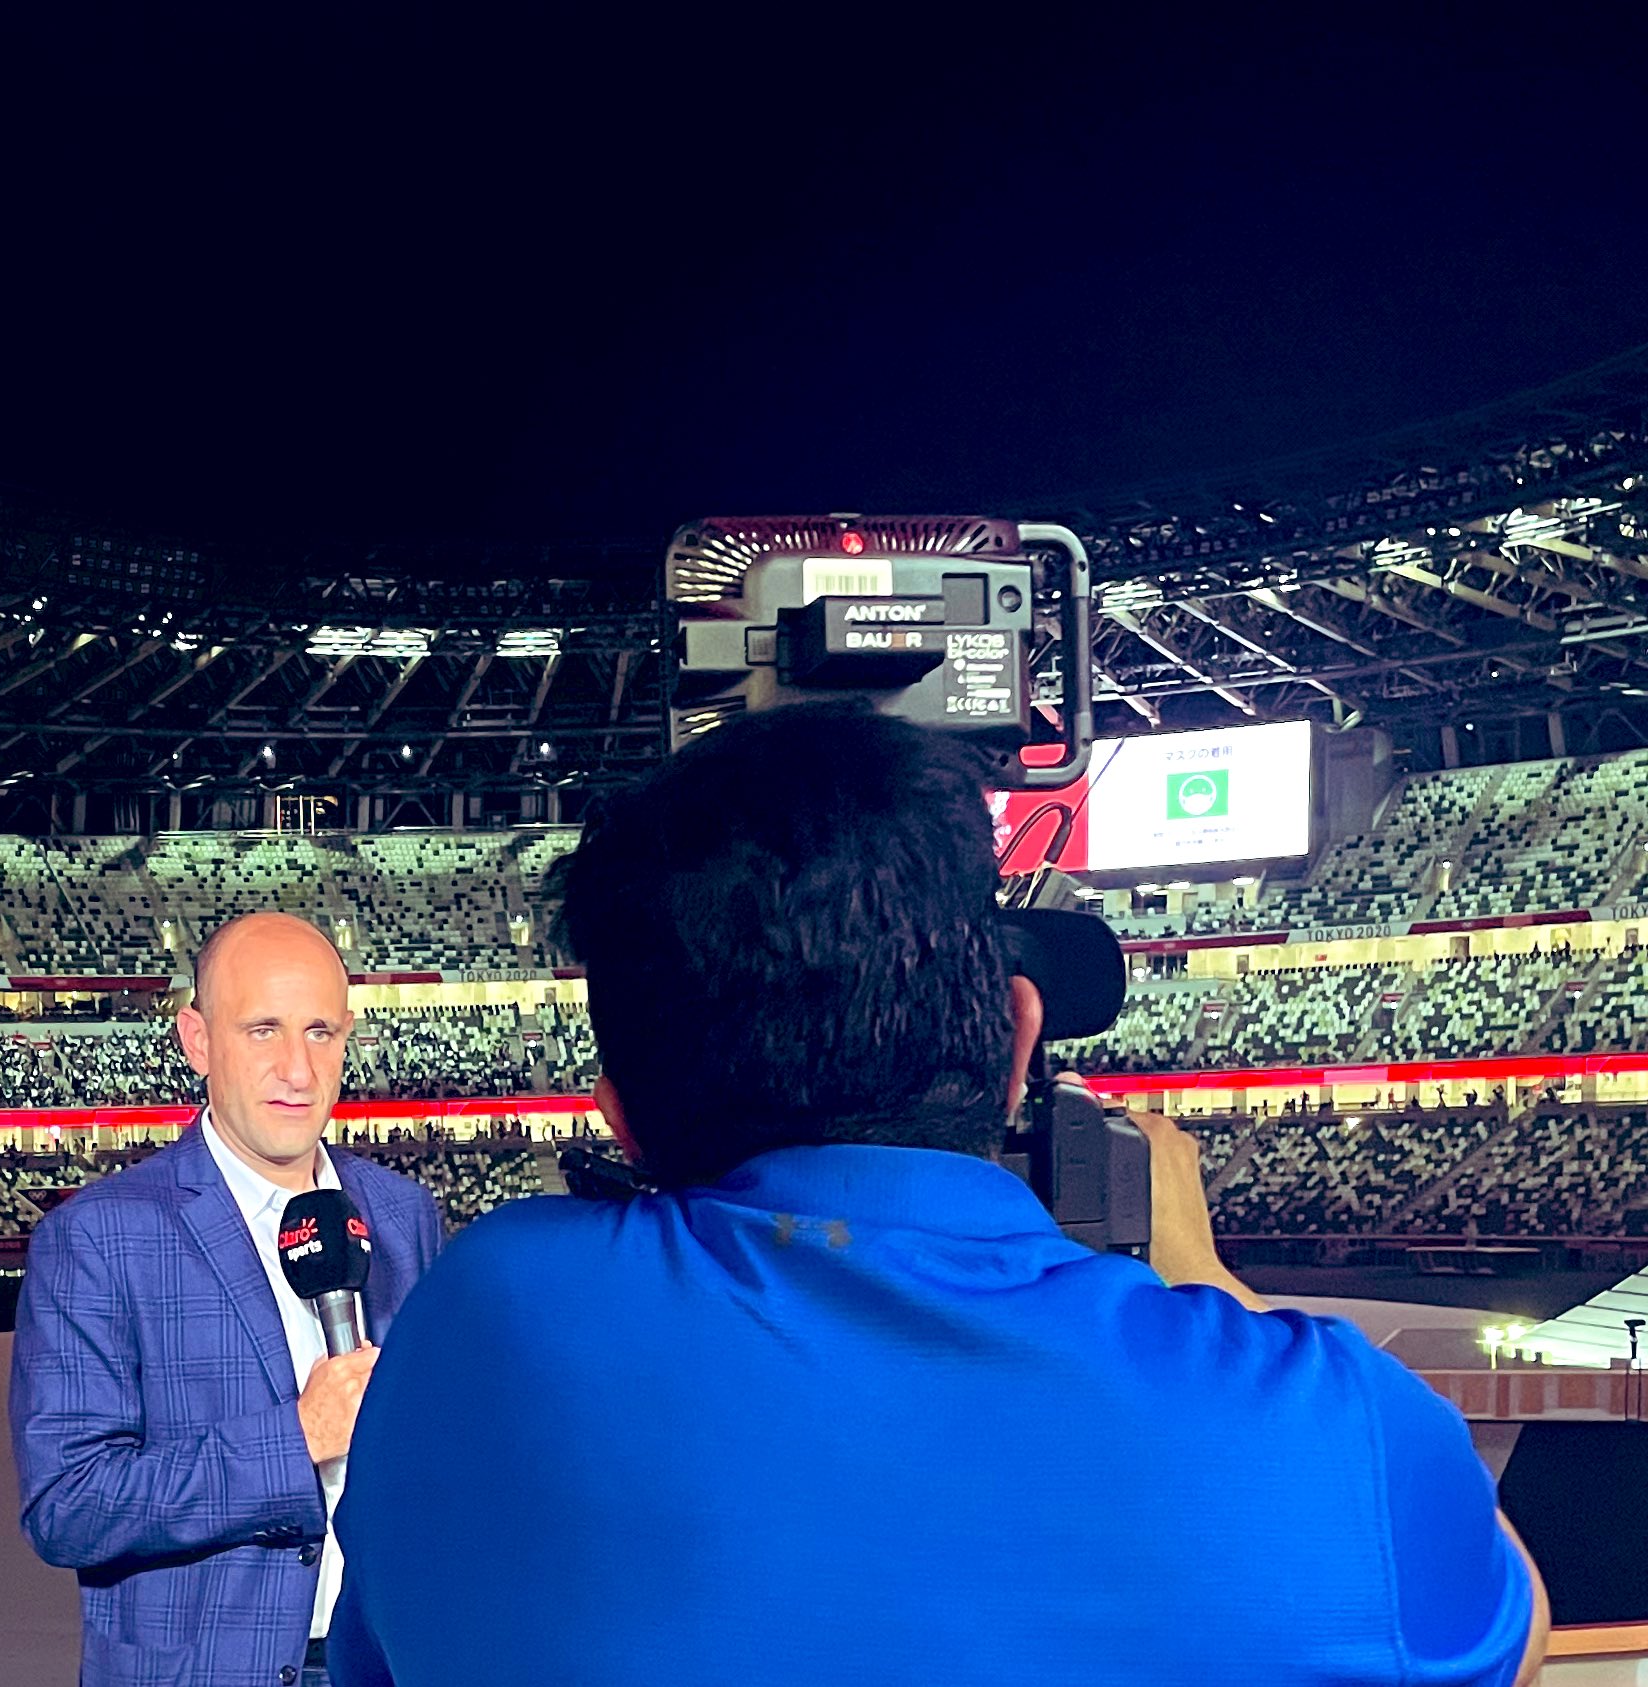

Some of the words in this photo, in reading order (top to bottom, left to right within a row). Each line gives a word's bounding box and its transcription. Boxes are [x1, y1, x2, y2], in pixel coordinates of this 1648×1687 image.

[947, 634, 1005, 648] LYKOS
[1306, 926, 1353, 942] TOKYO
[1356, 924, 1392, 939] 2020
[459, 969, 502, 983] TOKYO
[505, 969, 538, 982] 2020
